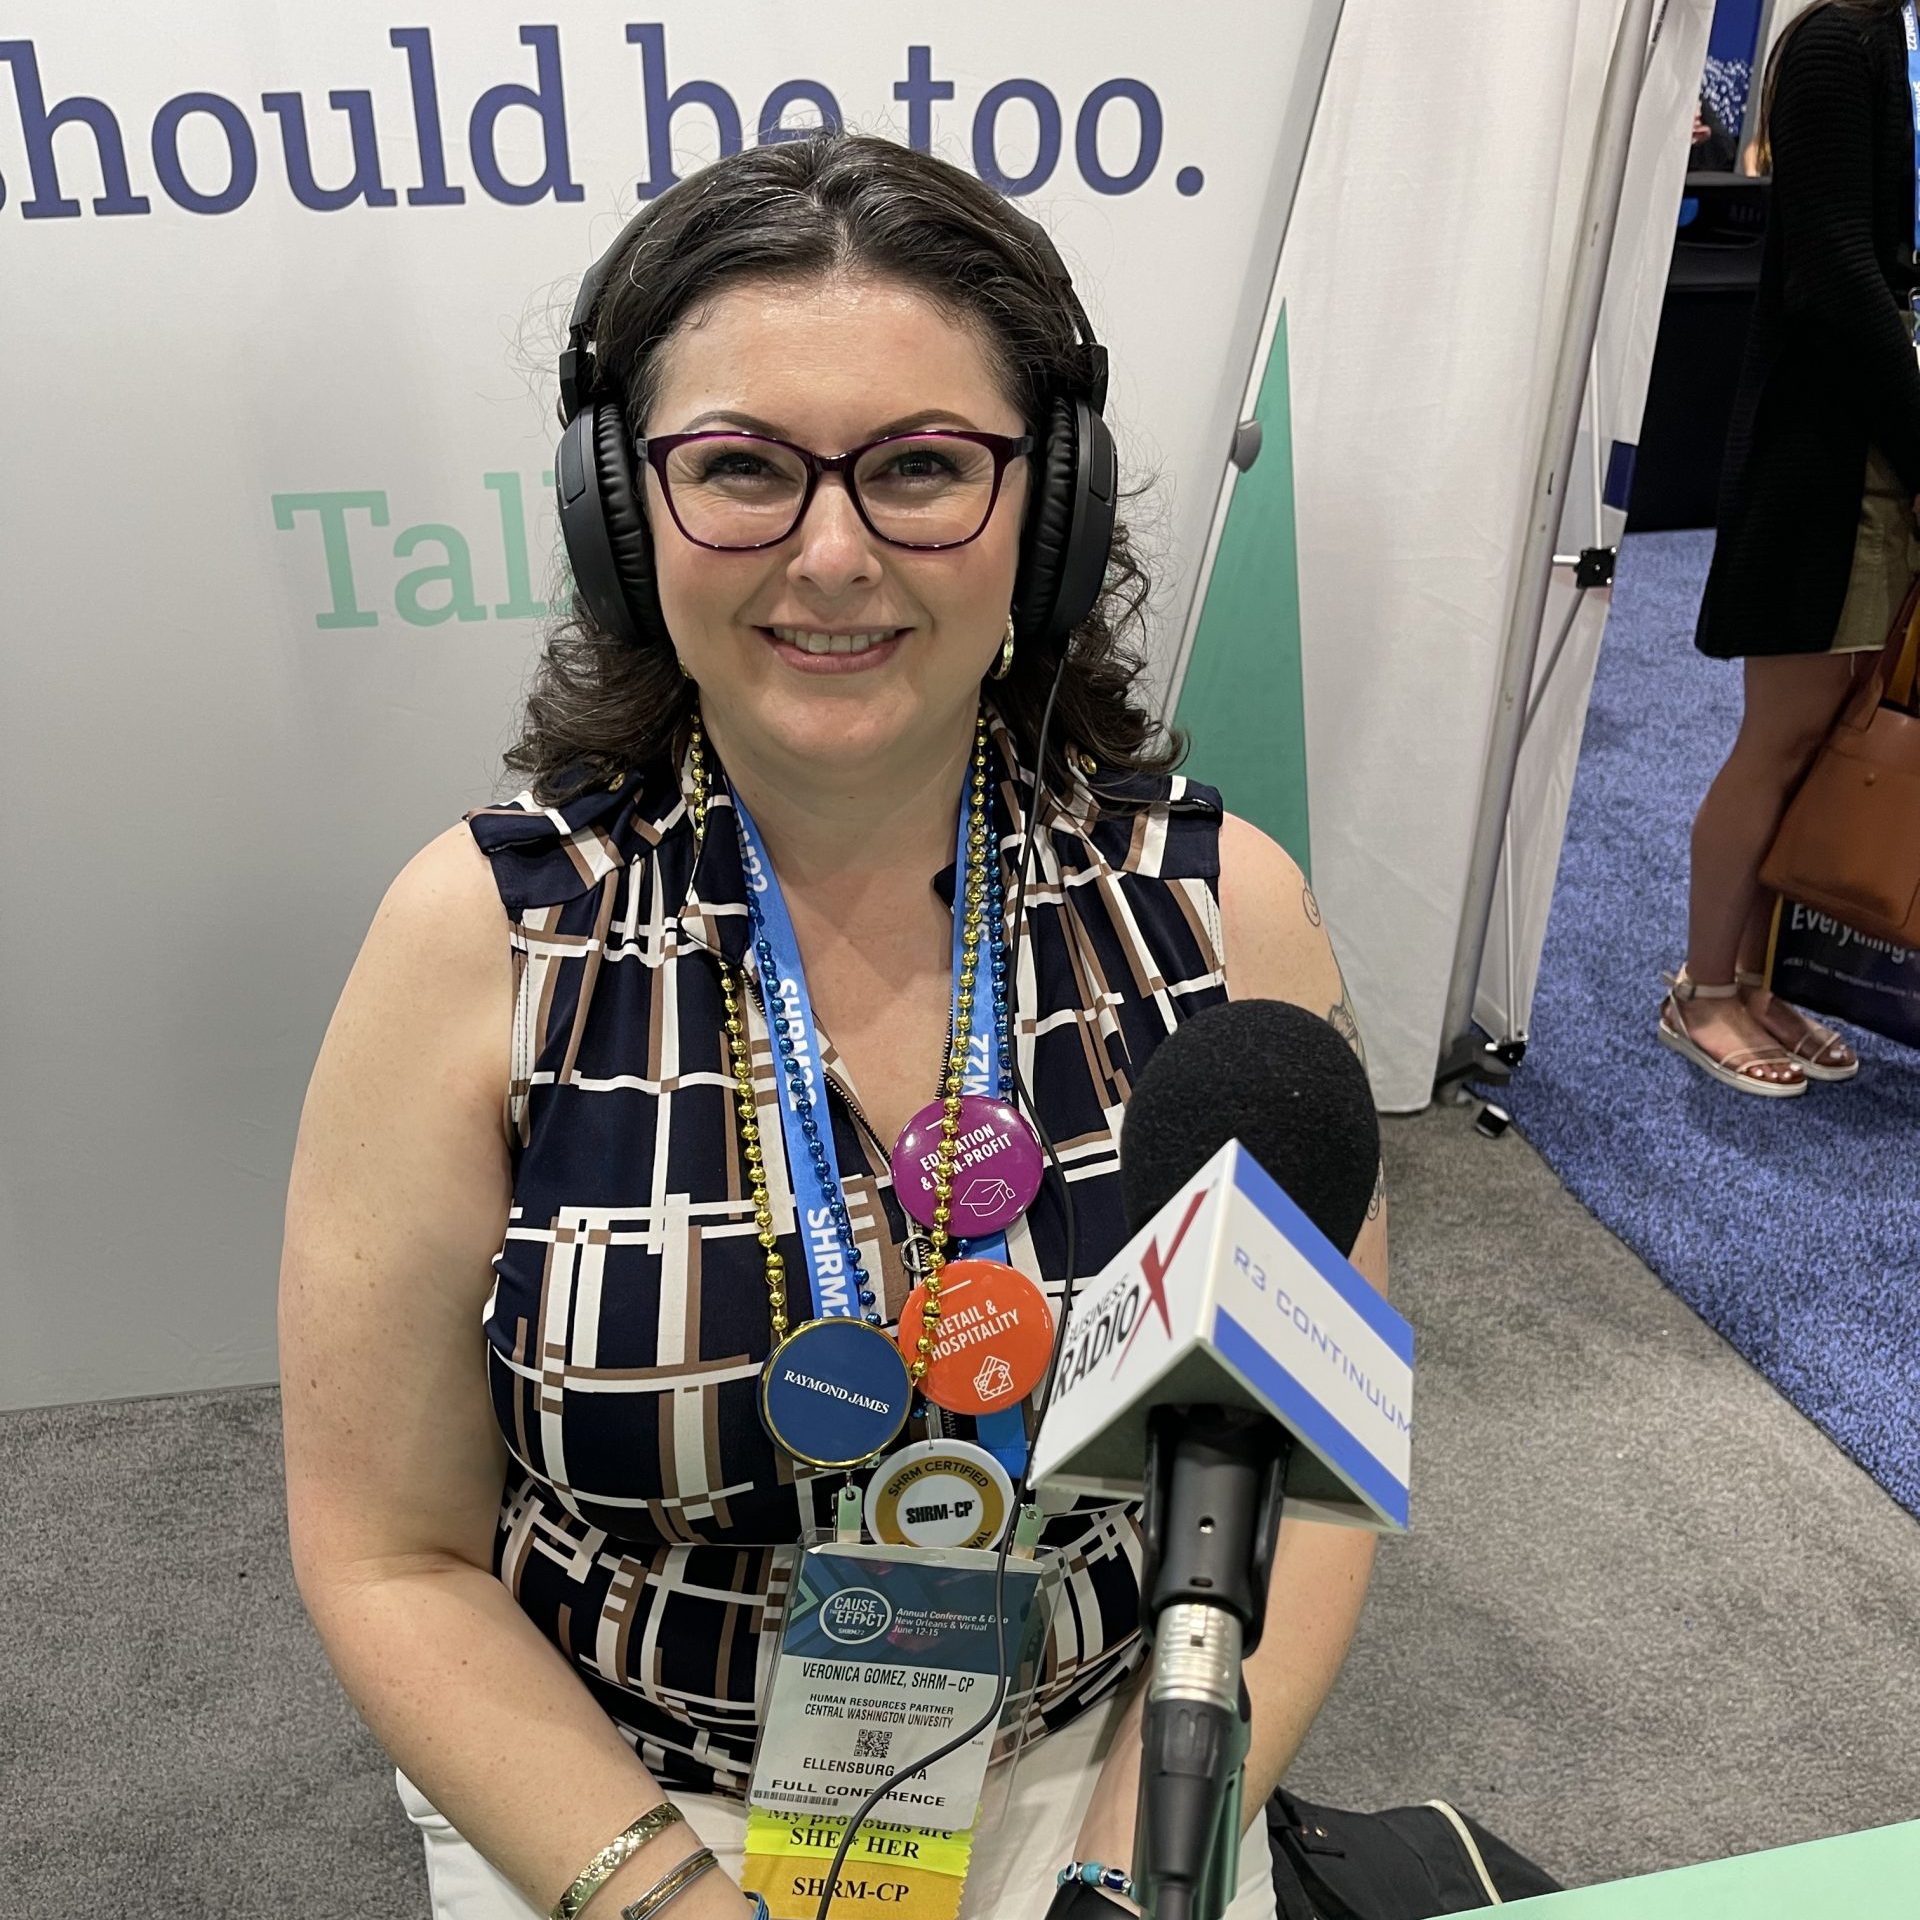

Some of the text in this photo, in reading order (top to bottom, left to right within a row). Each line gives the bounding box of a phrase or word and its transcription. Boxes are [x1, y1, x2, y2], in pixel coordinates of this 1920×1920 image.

[0, 25, 585, 219] hould
[893, 45, 1206, 197] too.
[271, 471, 575, 628] Tal
[919, 1123, 996, 1172] EDUATION
[920, 1133, 1012, 1191] & NN-PROFIT
[807, 1206, 851, 1318] SHRM
[936, 1299, 998, 1338] RETAIL &
[930, 1308, 1020, 1362] HOSPITALITY
[1233, 1246, 1412, 1433] R3 CONTINUUM
[784, 1369, 890, 1415] RAYMOND JAMES
[888, 1460, 989, 1497] SHRM CERTIFIED
[906, 1500, 973, 1524] SHRM-CP
[834, 1596, 878, 1613] CAUSE
[896, 1608, 928, 1617] Annual
[929, 1610, 978, 1622] Conference
[978, 1614, 986, 1623] &
[892, 1625, 940, 1637] June 12-15
[894, 1616, 988, 1632] New Orleans & Virtual
[802, 1661, 860, 1683] VERONICA
[863, 1667, 907, 1689] GOMEZ,
[804, 1703, 954, 1729] CENTRAL WASHINGTON UNIVESITY
[809, 1693, 954, 1716] HUMAN RESOURCES PARTNER
[802, 1757, 895, 1777] ELLENSBURG
[771, 1779, 947, 1807] FULL CONFRENCE
[809, 1813, 912, 1835] proouns
[789, 1827, 920, 1860] SHE HER
[791, 1876, 910, 1903] SHRM-CP
